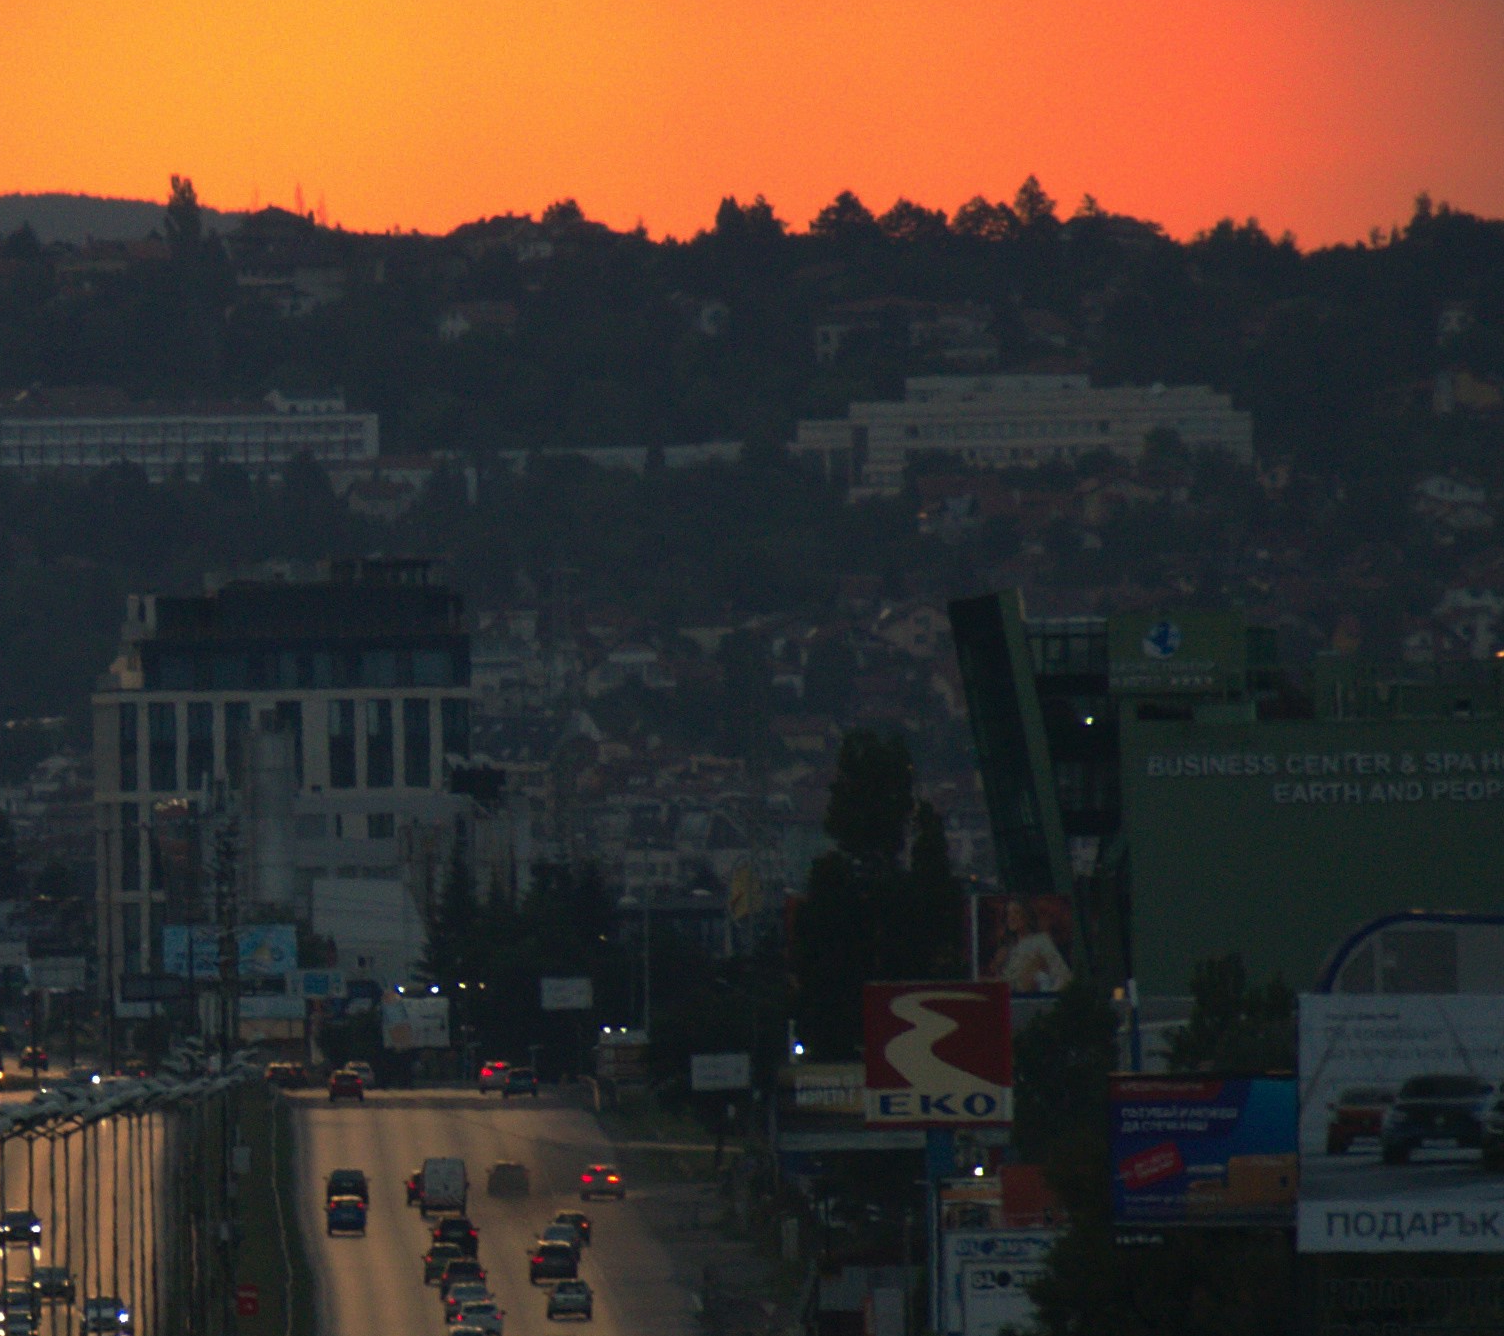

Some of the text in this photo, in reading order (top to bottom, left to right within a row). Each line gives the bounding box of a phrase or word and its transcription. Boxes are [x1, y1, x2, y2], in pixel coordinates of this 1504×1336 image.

[1147, 754, 1278, 777] BUSINESS
[1285, 752, 1391, 775] CENTER
[1399, 752, 1418, 774] &
[1425, 752, 1478, 773] SPA
[1273, 782, 1362, 805] EARTH
[1369, 781, 1423, 803] AND
[878, 1092, 997, 1117] EKO
[1325, 1210, 1499, 1242] ПОДАРЪК
